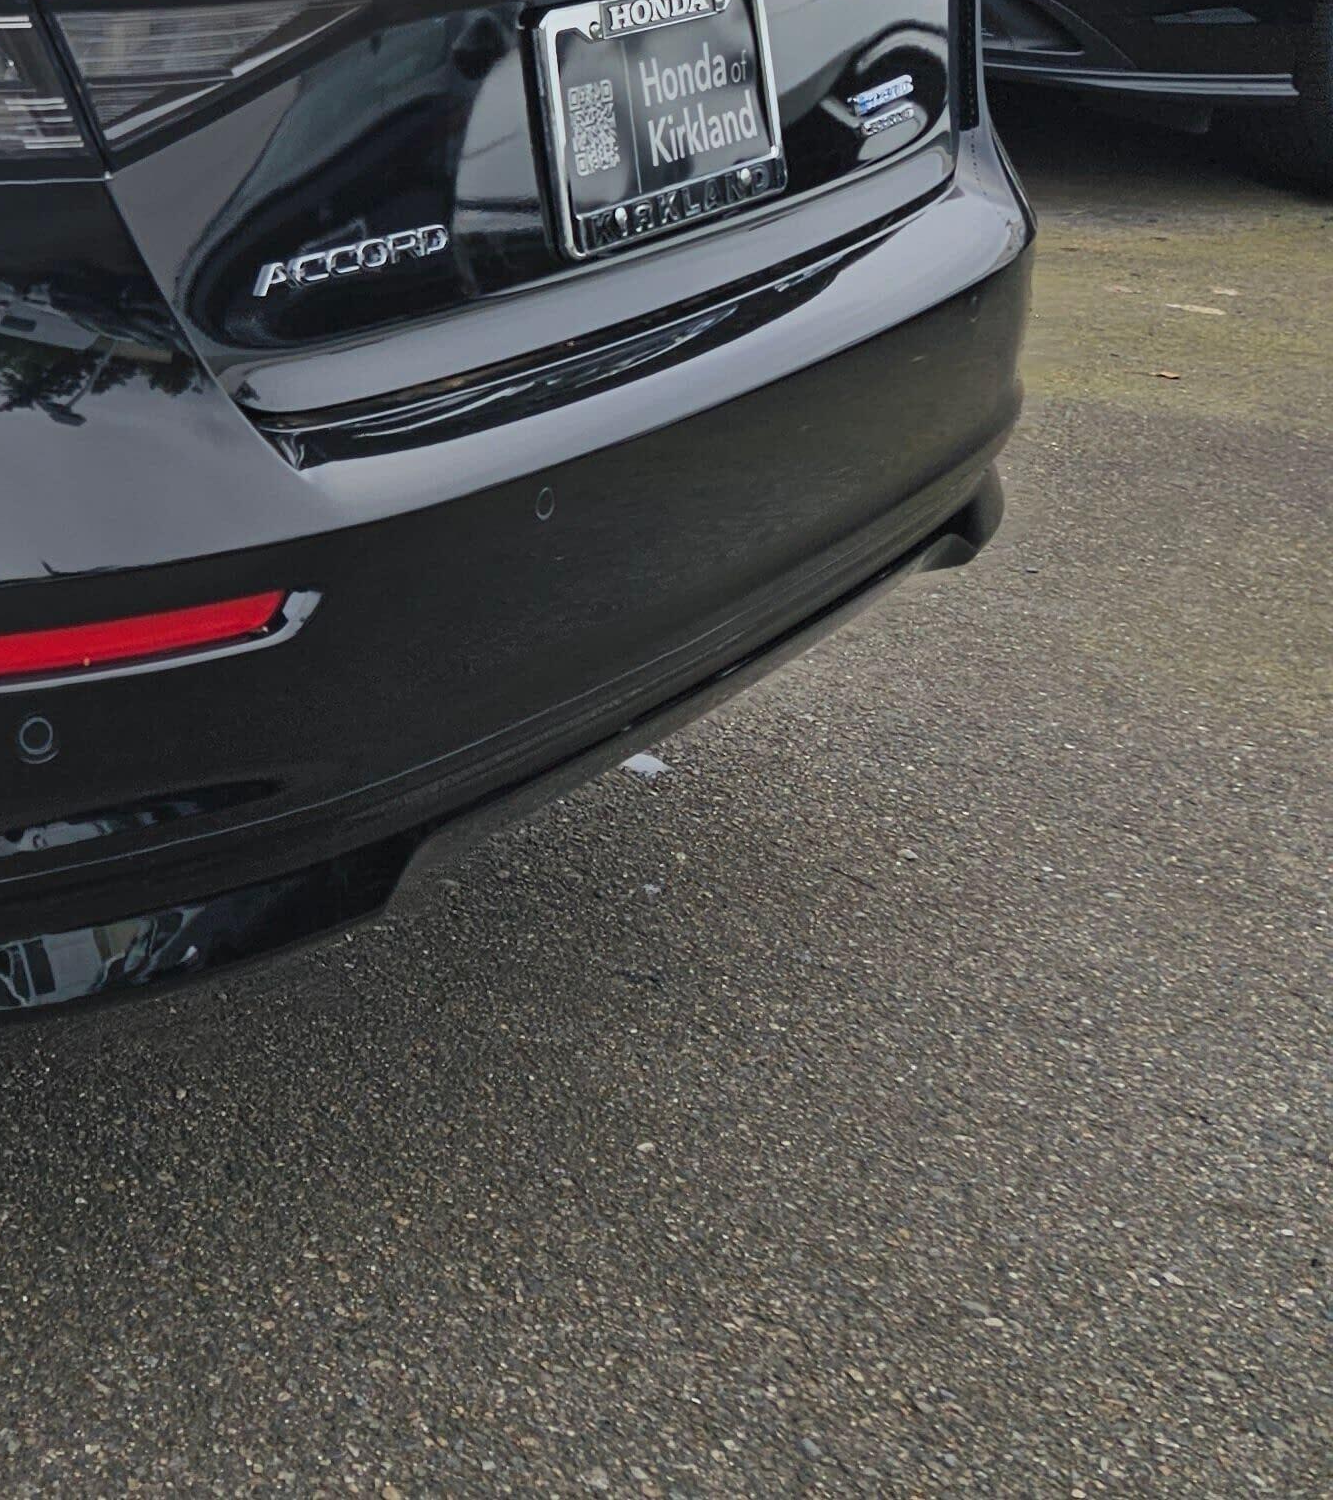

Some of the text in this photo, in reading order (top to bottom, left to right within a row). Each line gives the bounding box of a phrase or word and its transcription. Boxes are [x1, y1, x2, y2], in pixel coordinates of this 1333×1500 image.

[639, 41, 748, 107] Honda of
[647, 89, 759, 167] Kirkland
[252, 224, 448, 298] ACCORD
